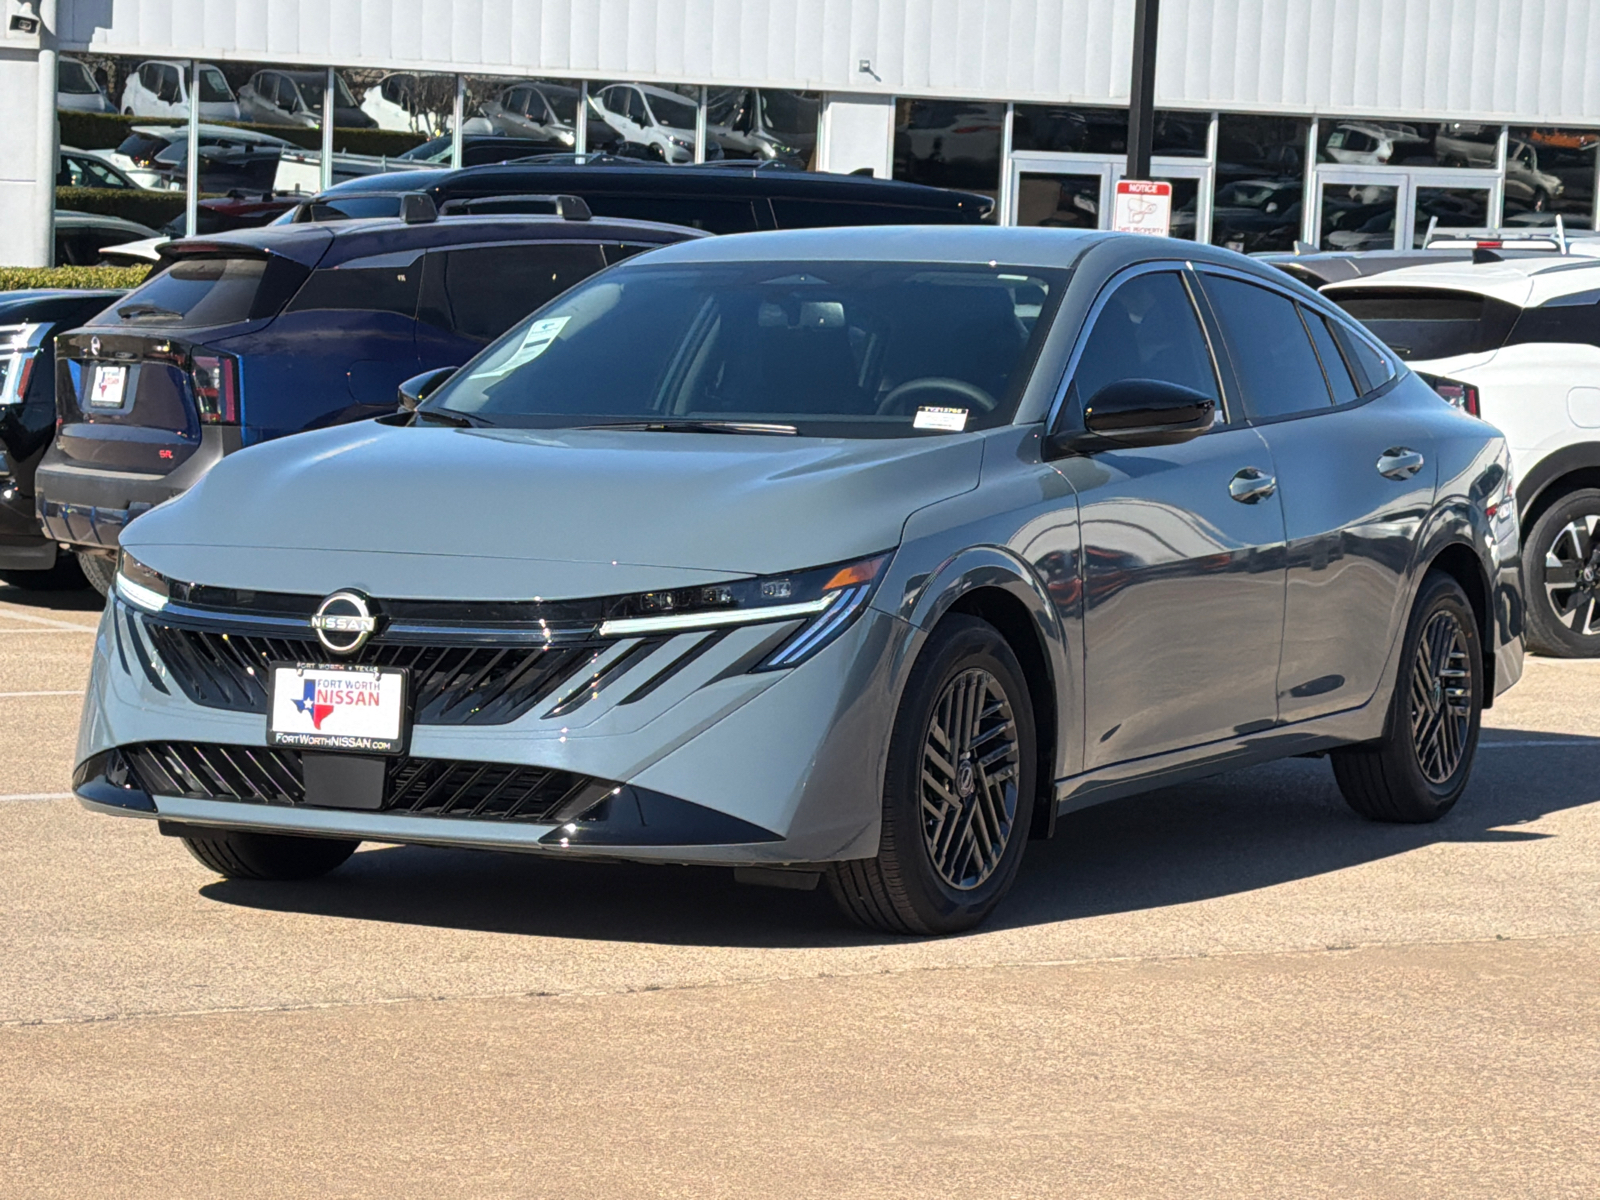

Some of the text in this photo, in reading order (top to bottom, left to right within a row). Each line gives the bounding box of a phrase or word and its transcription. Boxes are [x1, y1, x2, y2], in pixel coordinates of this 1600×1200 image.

[1129, 183, 1158, 194] NOTICE
[159, 449, 173, 459] SR
[311, 615, 373, 631] NISSAN
[317, 679, 380, 691] FORT WORTH
[316, 689, 380, 707] NISSAN
